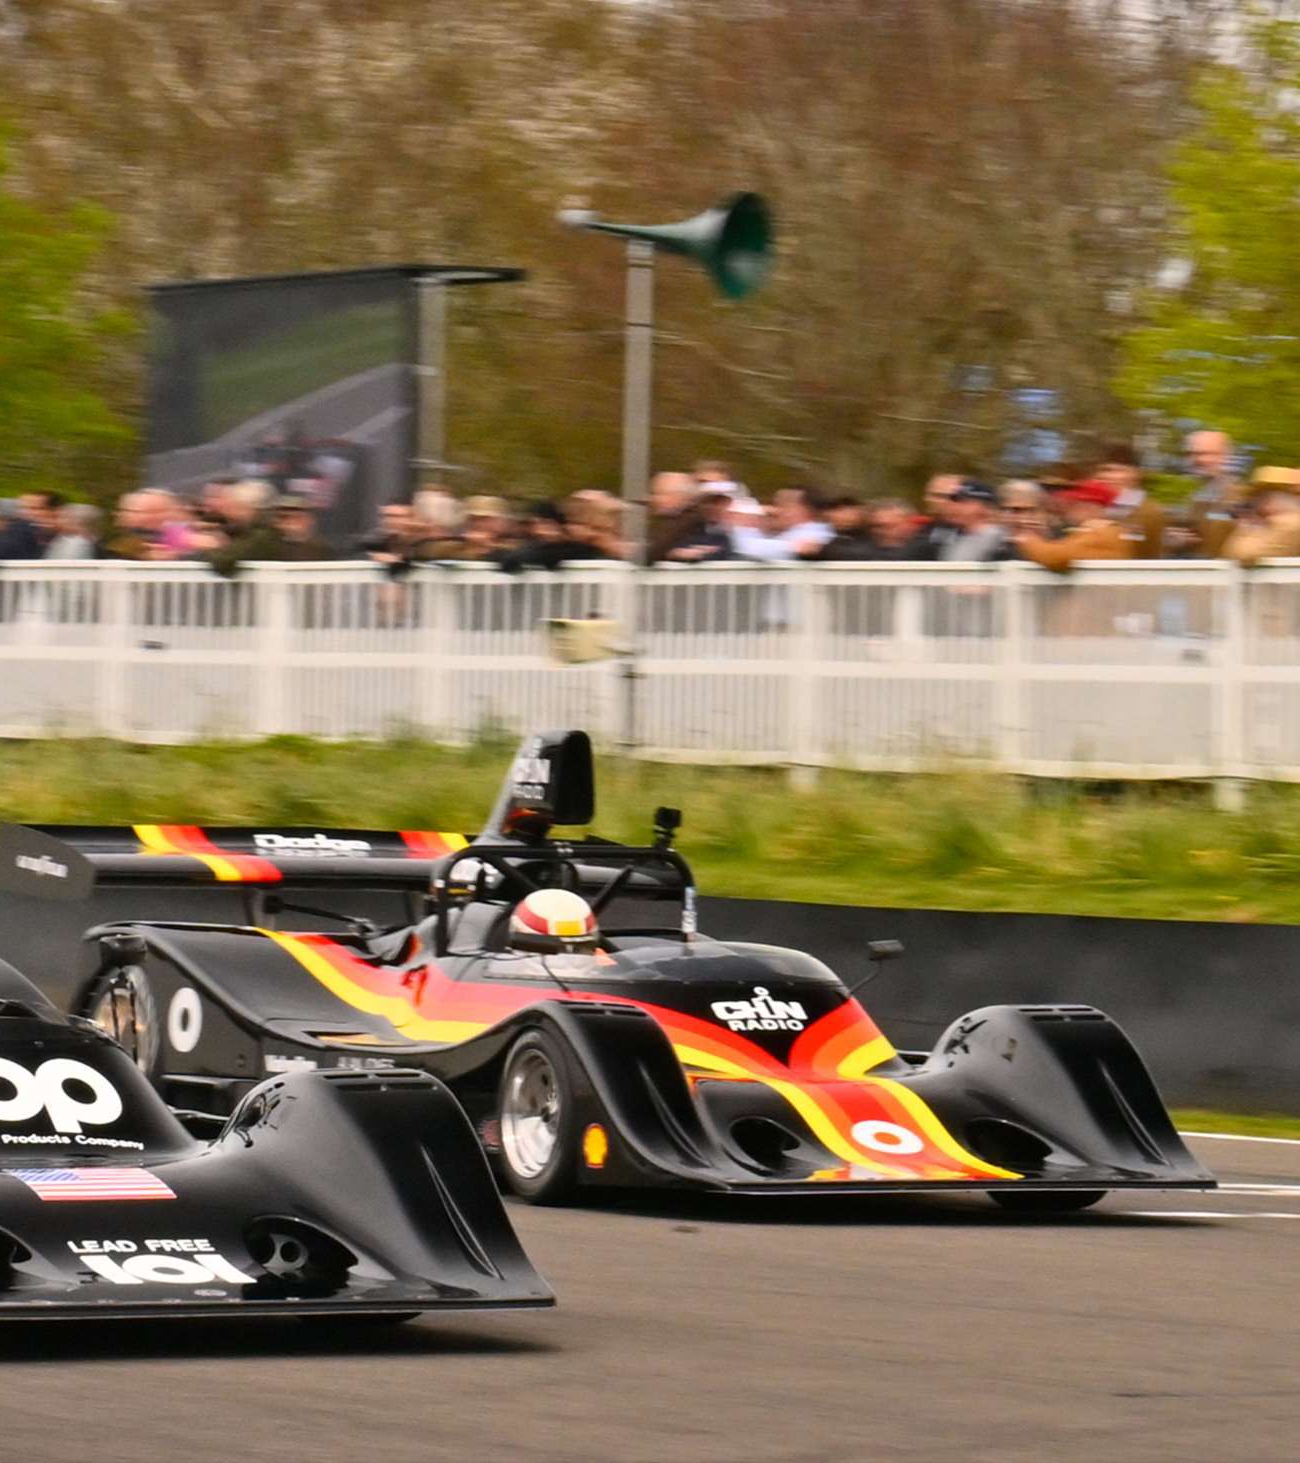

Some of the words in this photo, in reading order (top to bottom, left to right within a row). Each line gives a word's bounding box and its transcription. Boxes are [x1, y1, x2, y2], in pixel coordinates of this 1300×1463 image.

[727, 1018, 804, 1031] RADIO
[0, 1133, 72, 1145] Products
[74, 1134, 145, 1151] Company
[66, 1239, 138, 1253] LEAD
[144, 1238, 216, 1253] FREE
[78, 1254, 258, 1285] 101
